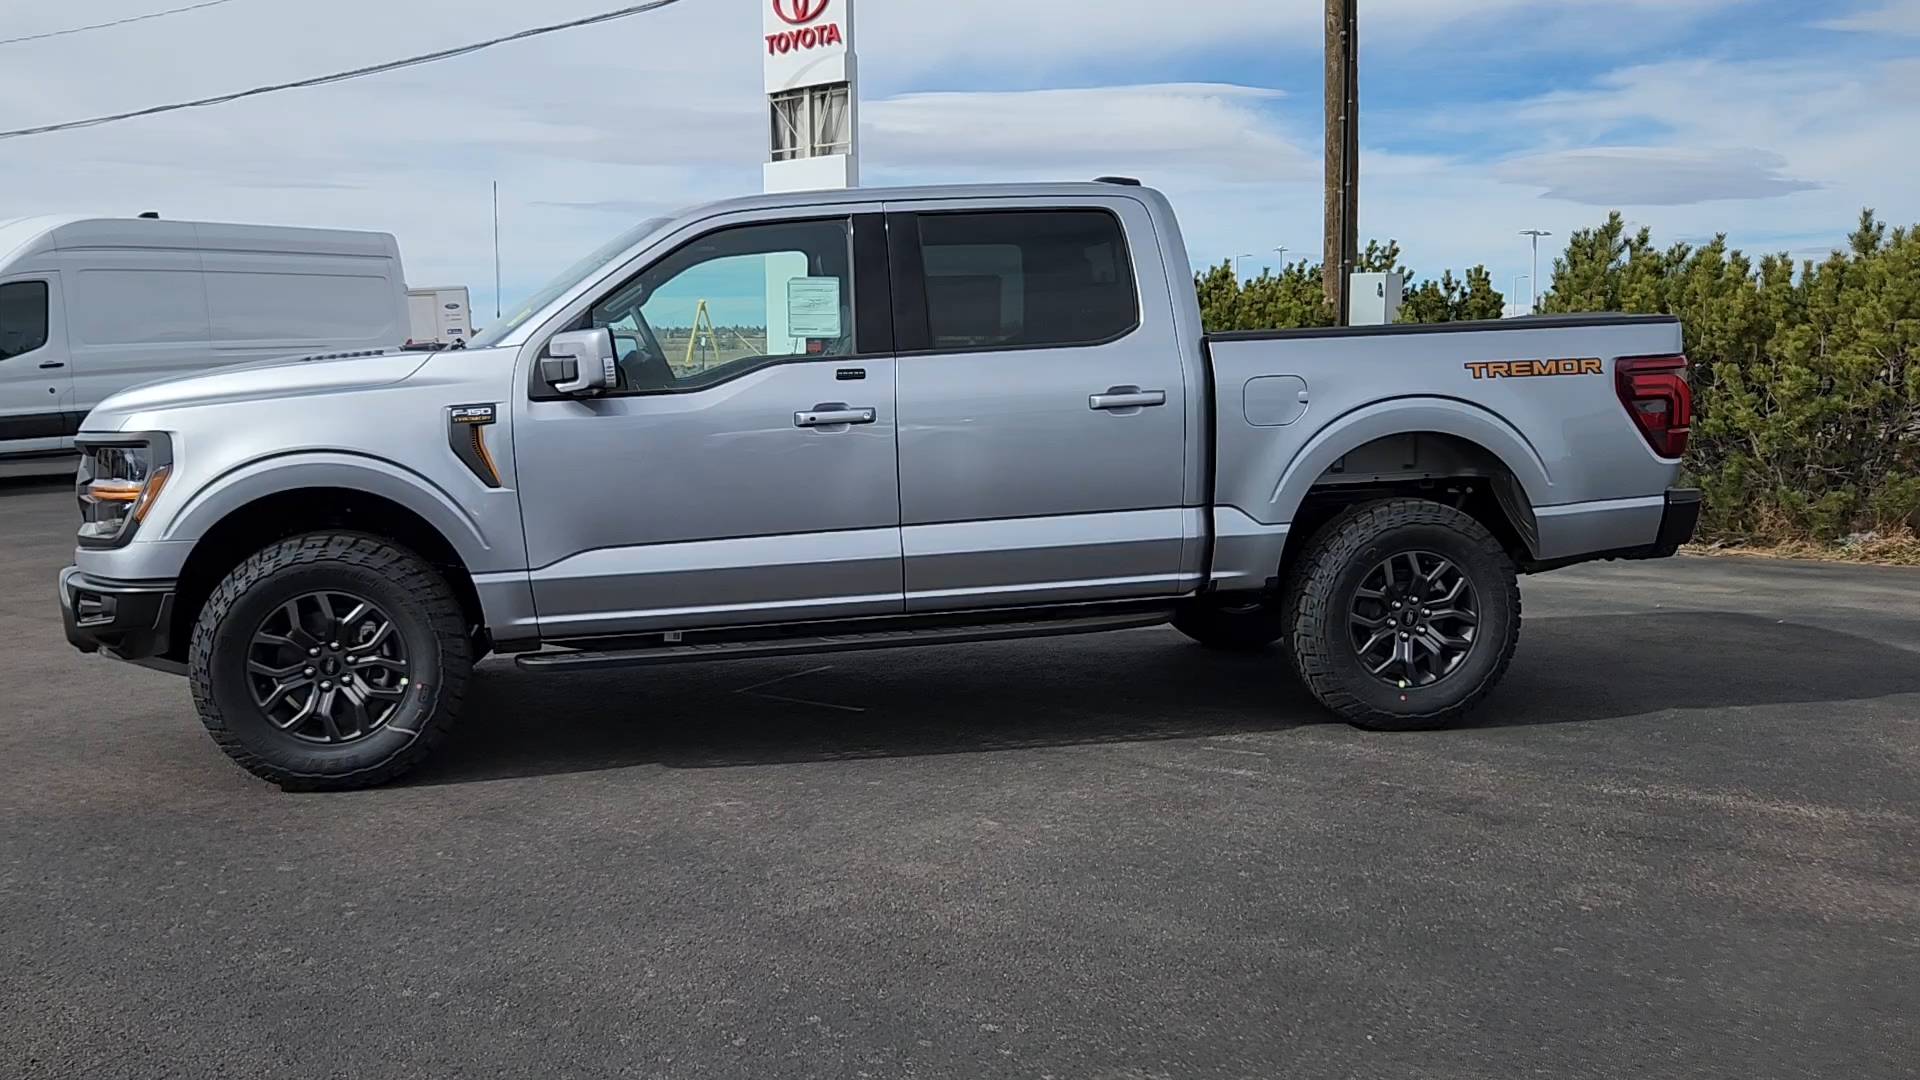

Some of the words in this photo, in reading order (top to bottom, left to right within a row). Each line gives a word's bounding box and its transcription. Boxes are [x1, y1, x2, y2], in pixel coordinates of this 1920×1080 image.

[765, 23, 842, 56] TOYOTA
[1464, 357, 1604, 379] TREMOR
[452, 407, 492, 417] F-150
